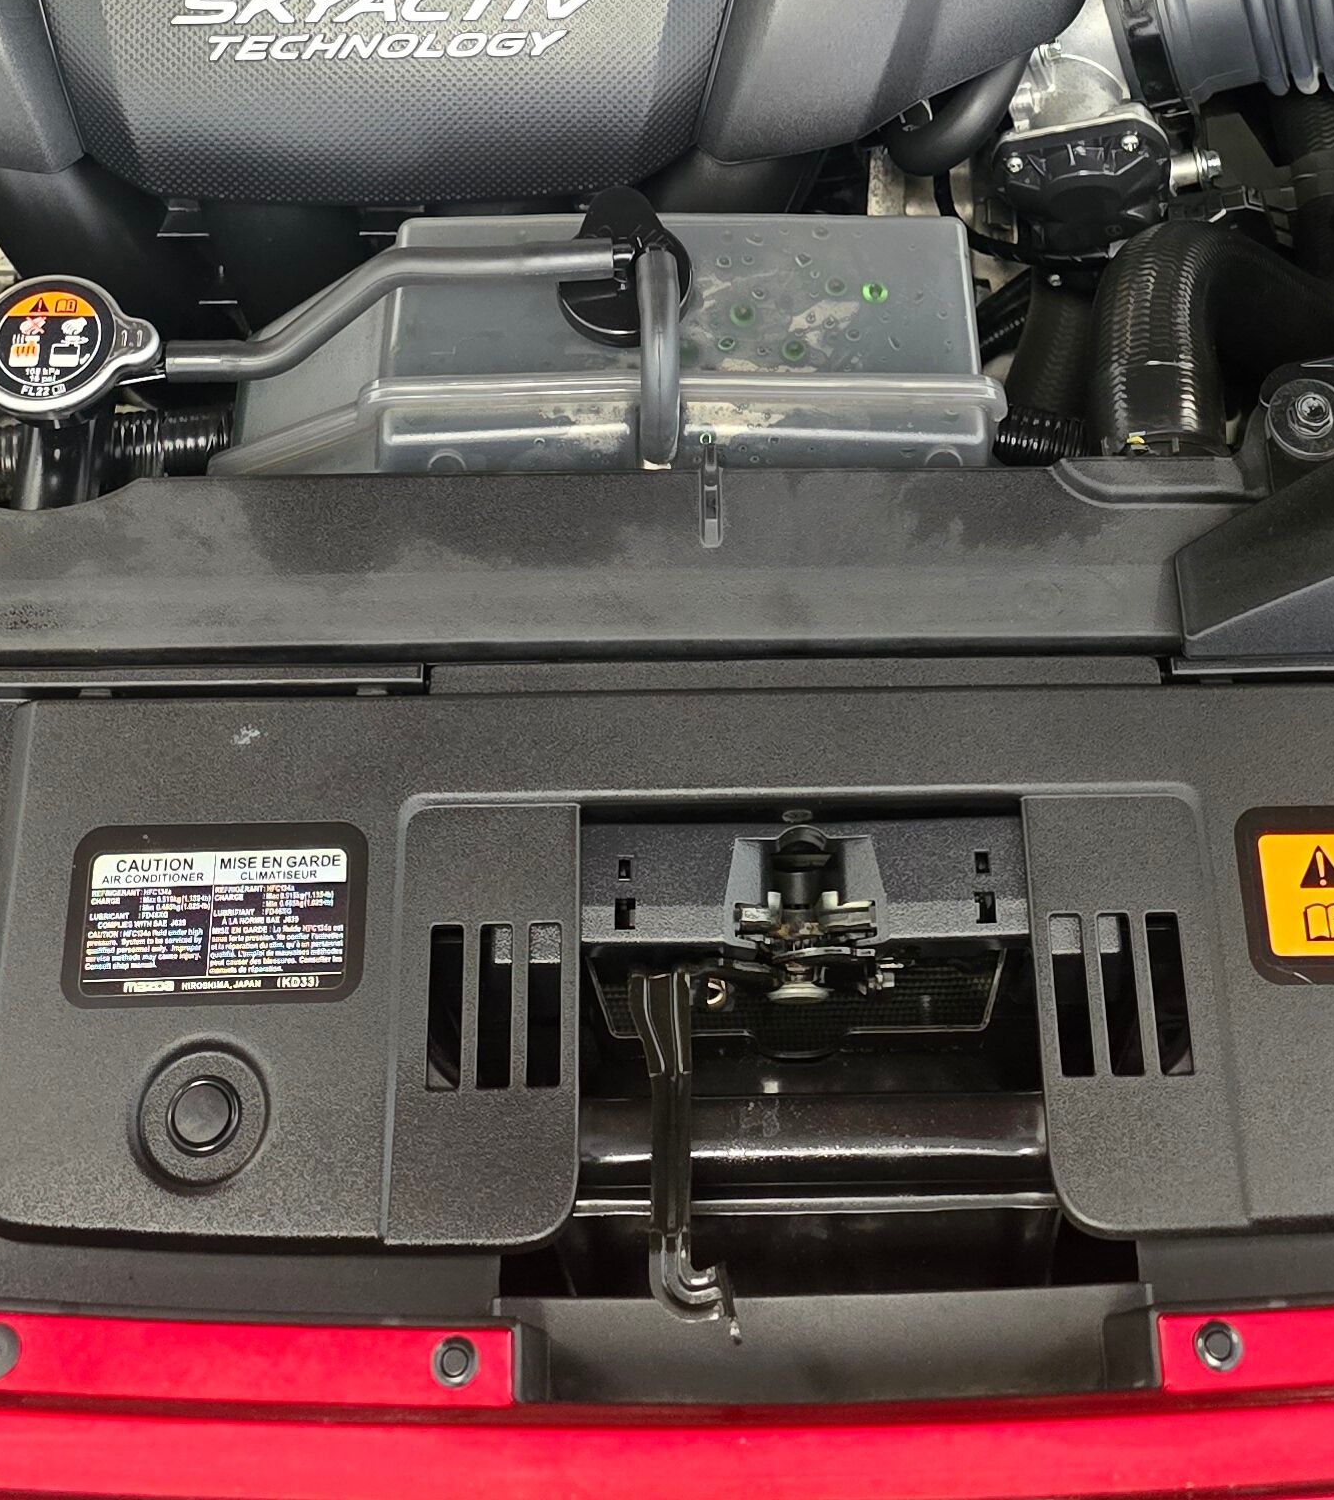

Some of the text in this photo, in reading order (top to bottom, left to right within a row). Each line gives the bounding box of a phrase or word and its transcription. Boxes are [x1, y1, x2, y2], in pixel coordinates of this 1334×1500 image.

[207, 29, 568, 63] TECHNOLOGY
[20, 384, 51, 397] FL22
[116, 858, 194, 873] CAUTION
[220, 854, 341, 870] MISE EN GARDE
[102, 872, 204, 885] AIR CONDITIONER
[240, 869, 317, 881] CLIMATISEUR
[232, 979, 262, 989] JAPAN
[276, 976, 320, 988] (KD33)
